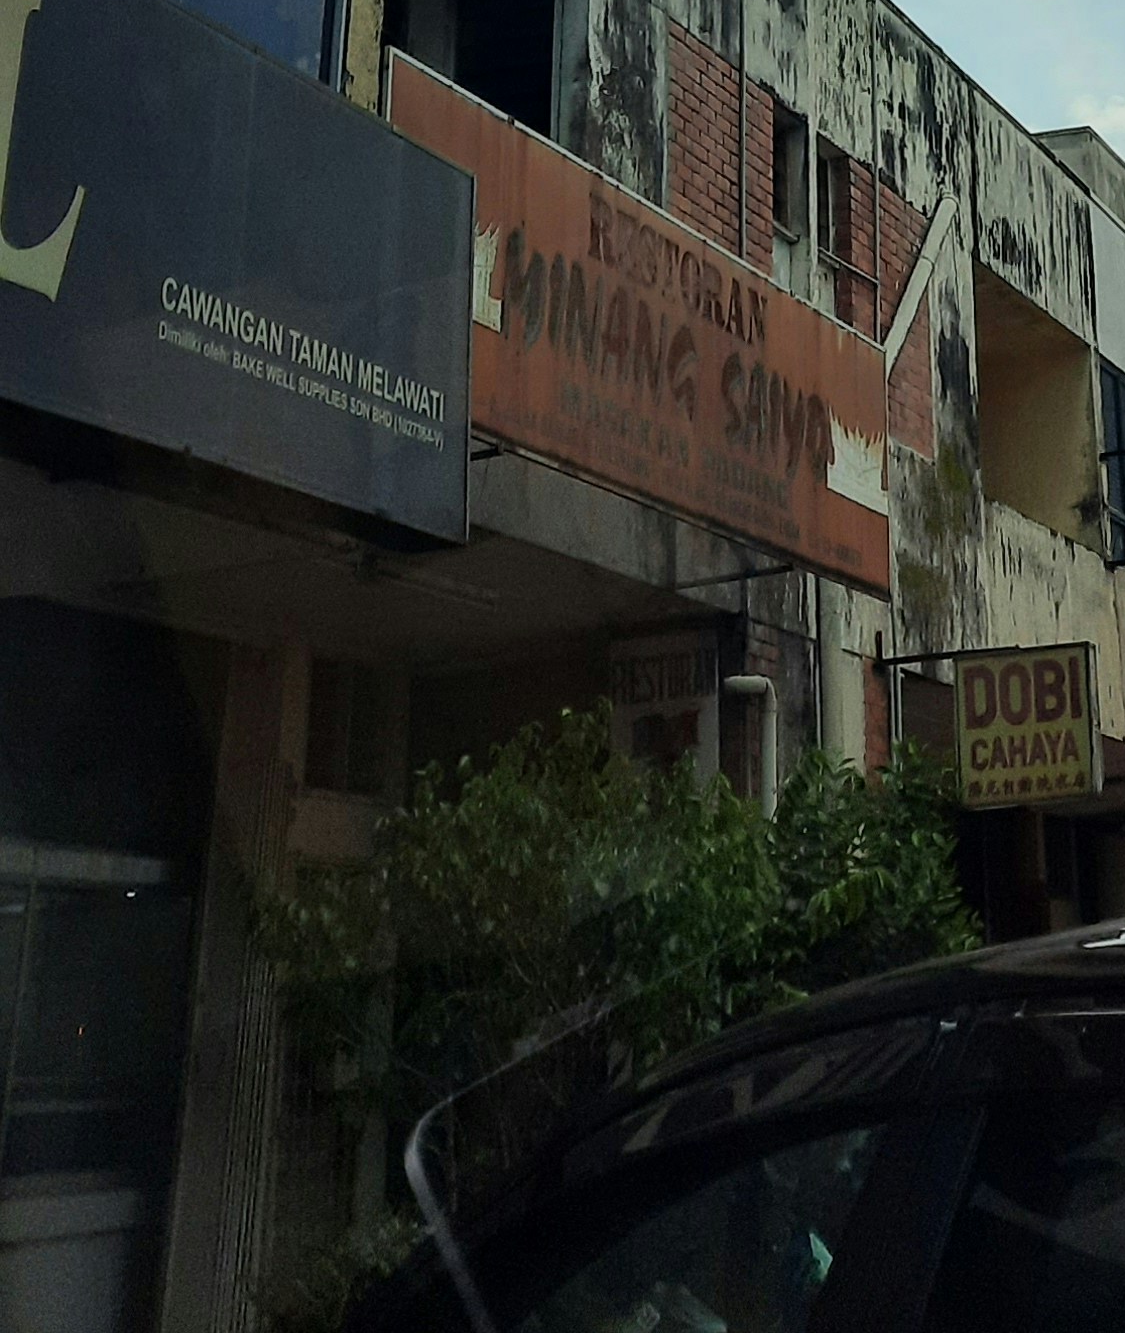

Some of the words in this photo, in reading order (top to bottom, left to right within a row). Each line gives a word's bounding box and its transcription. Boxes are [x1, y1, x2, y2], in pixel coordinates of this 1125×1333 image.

[503, 225, 697, 422] MINANG
[588, 190, 770, 347] RESTORAN
[161, 276, 284, 357] CAWANGAN
[289, 328, 354, 385] TAMAN
[357, 358, 446, 423] MELAWATI
[232, 350, 264, 380] BAKE
[265, 363, 296, 393] WELL
[297, 376, 348, 412] SUPPLIES
[349, 396, 370, 422] SDN
[372, 405, 393, 429] BHD
[962, 655, 1083, 731] DOBI
[970, 729, 1080, 771] CAHAYA
